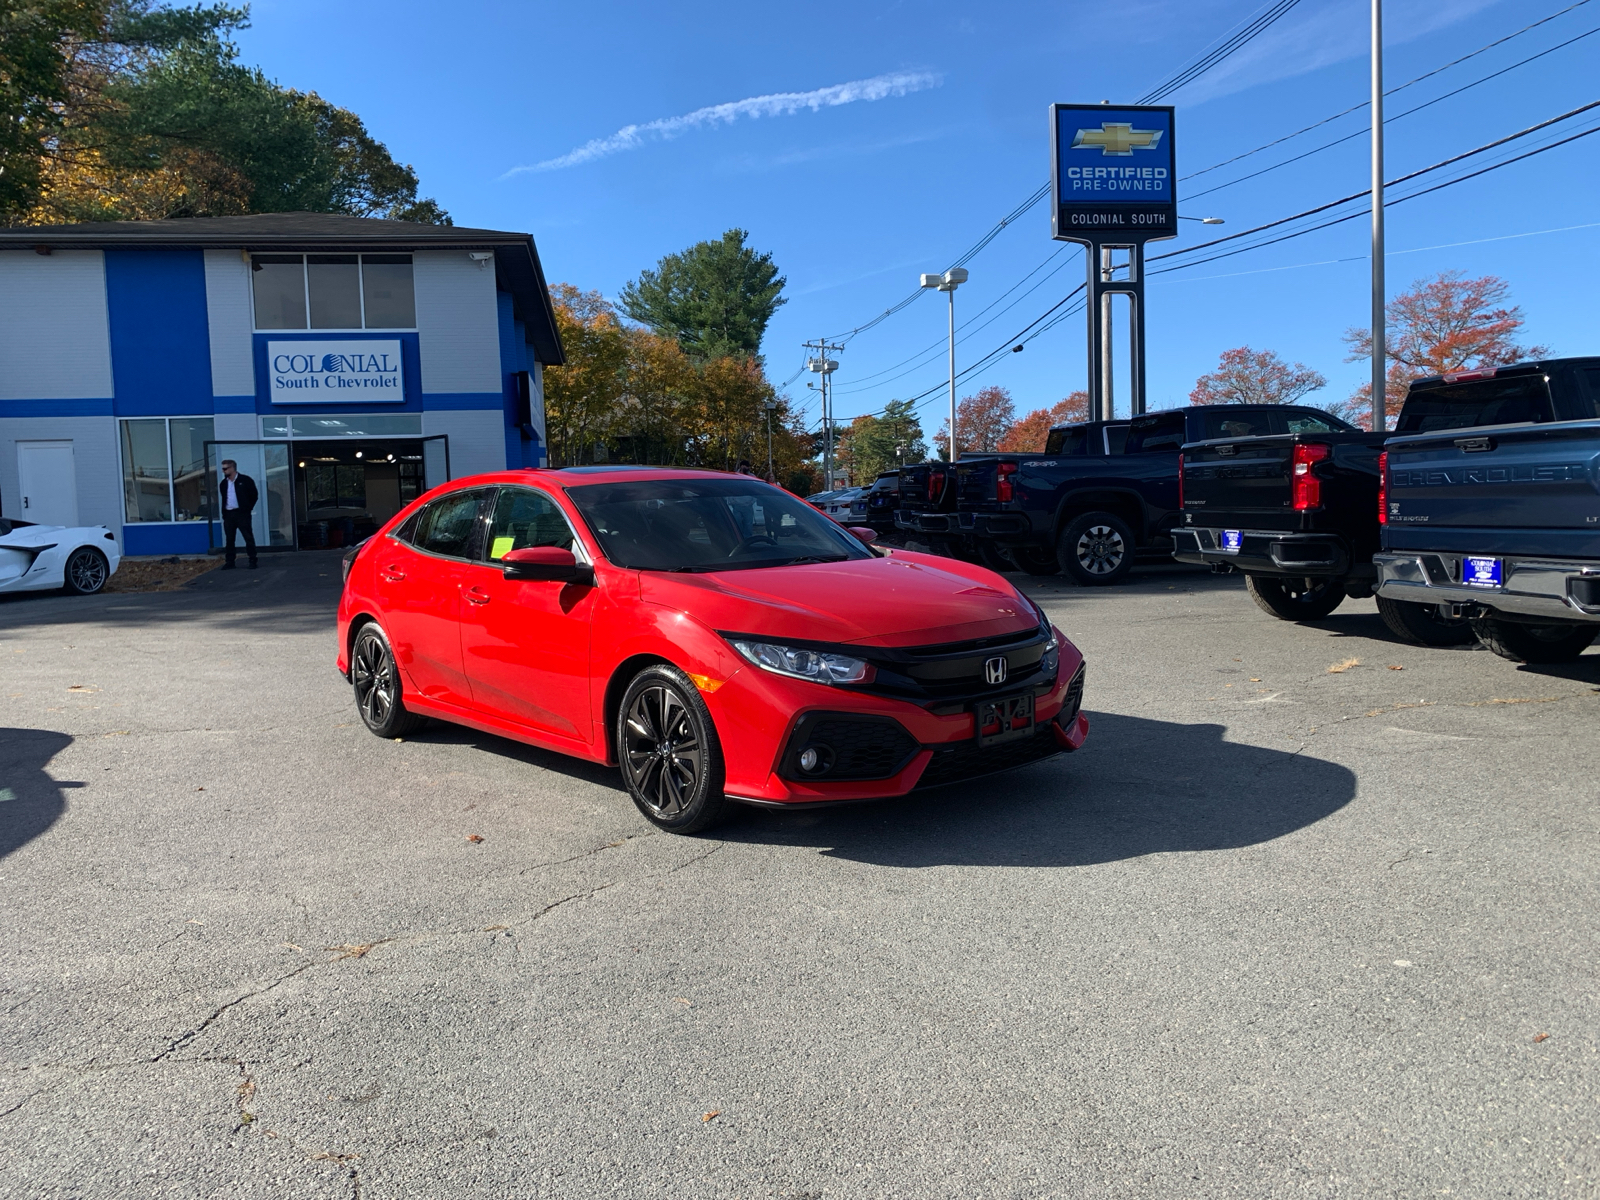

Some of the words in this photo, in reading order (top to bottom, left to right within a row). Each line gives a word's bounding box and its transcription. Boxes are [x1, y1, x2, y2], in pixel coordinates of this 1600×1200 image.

[1068, 167, 1167, 179] CERTIFIED
[1073, 180, 1163, 191] PRE-OWNED
[1071, 213, 1125, 224] COLONIAL
[1131, 213, 1166, 224] SOUTH
[273, 353, 398, 374] COLONIAL
[275, 375, 320, 389] South
[324, 374, 398, 388] Chevrolet
[1393, 464, 1583, 486] CHEVROLET
